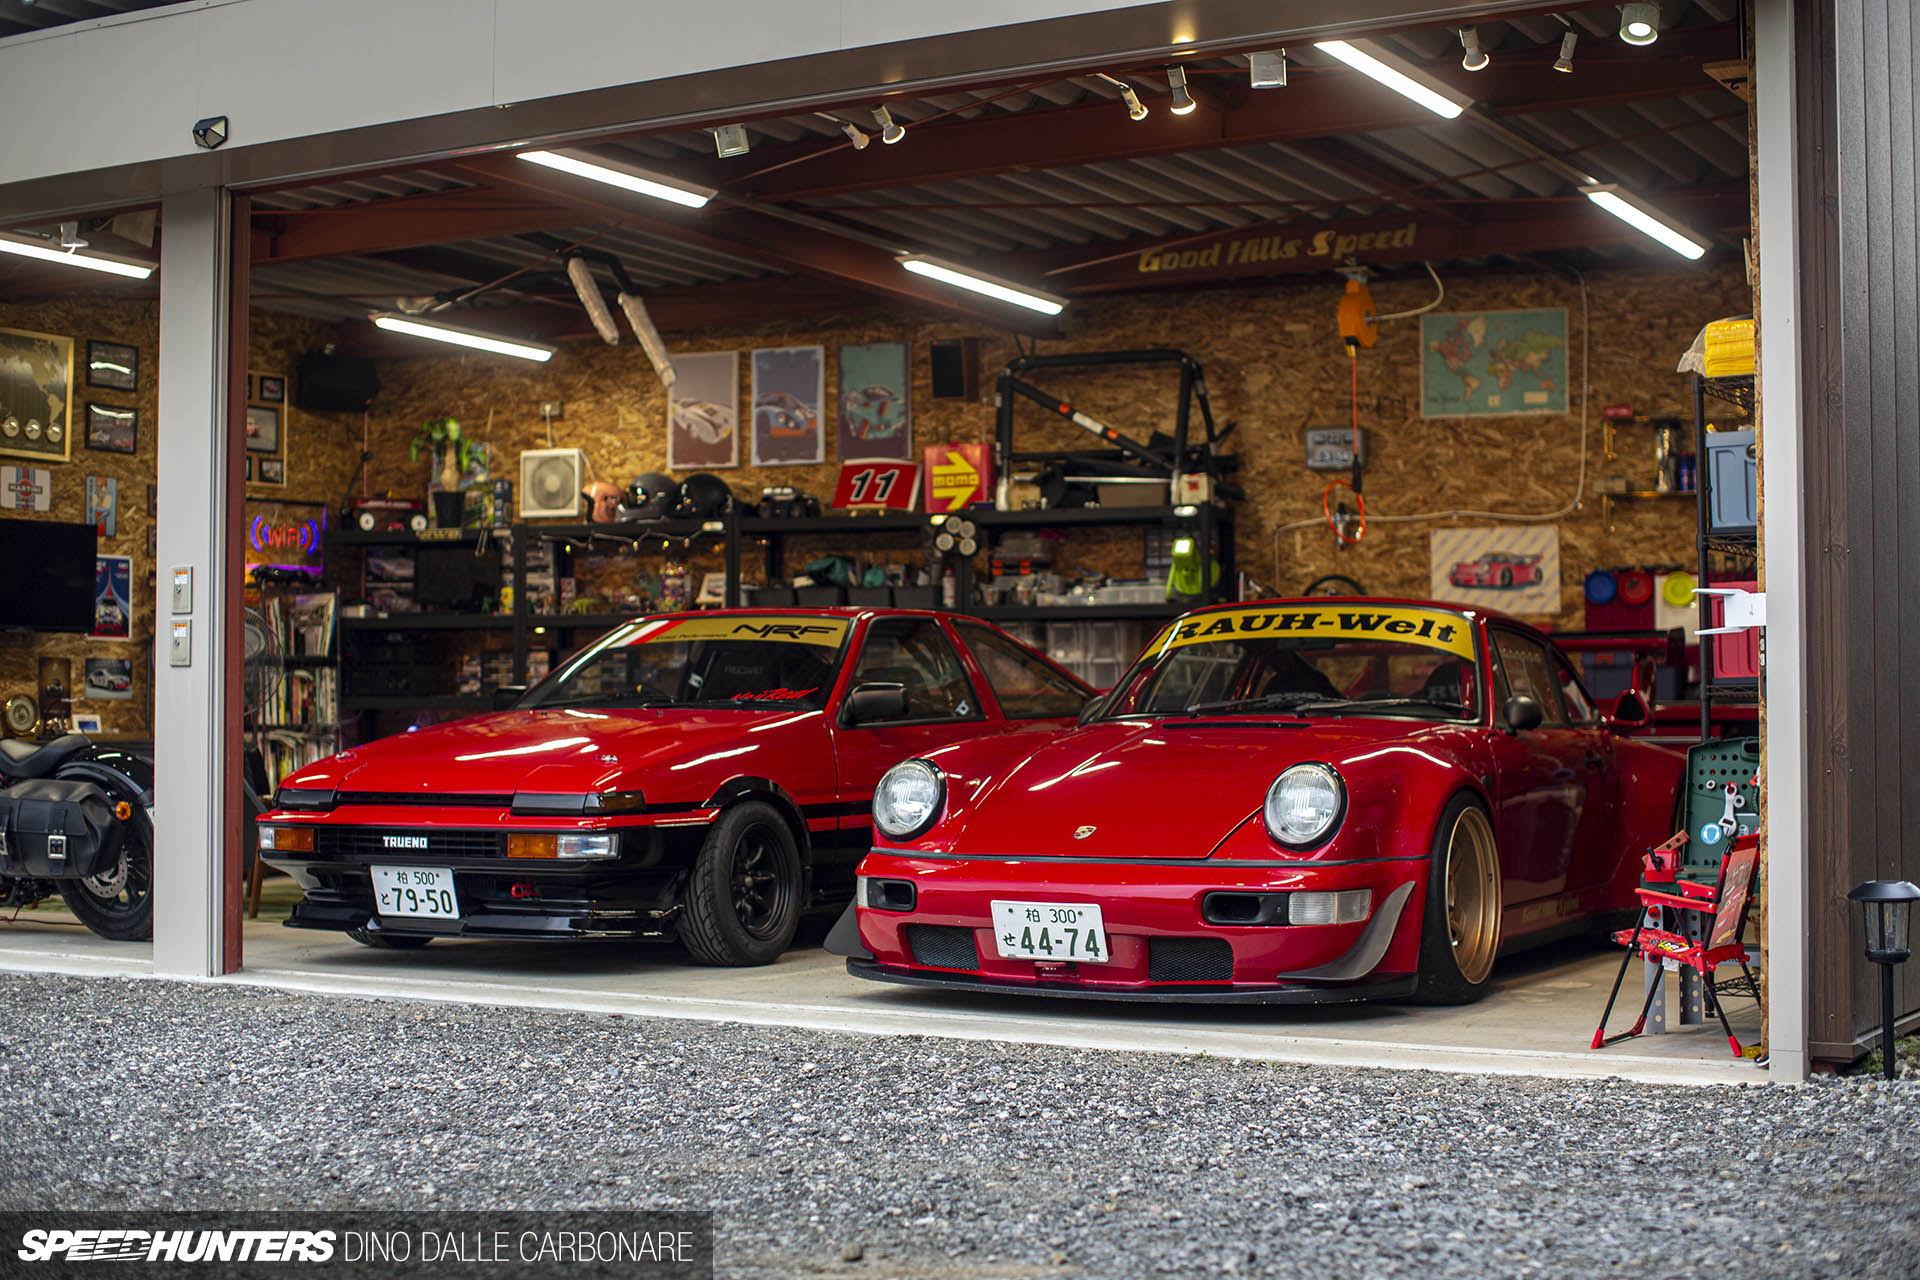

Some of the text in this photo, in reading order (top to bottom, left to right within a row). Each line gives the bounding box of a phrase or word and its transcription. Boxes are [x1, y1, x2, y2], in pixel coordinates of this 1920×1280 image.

[1137, 223, 1417, 272] Good Hills Speed
[850, 469, 899, 501] 11
[732, 624, 838, 639] NRF
[1162, 612, 1460, 645] RAUH-Welt
[382, 835, 428, 849] TRUENO
[413, 871, 435, 885] 500
[380, 887, 453, 914] と 79-50
[1025, 908, 1077, 924] 柏 300
[1002, 926, 1100, 957] せ 44-74
